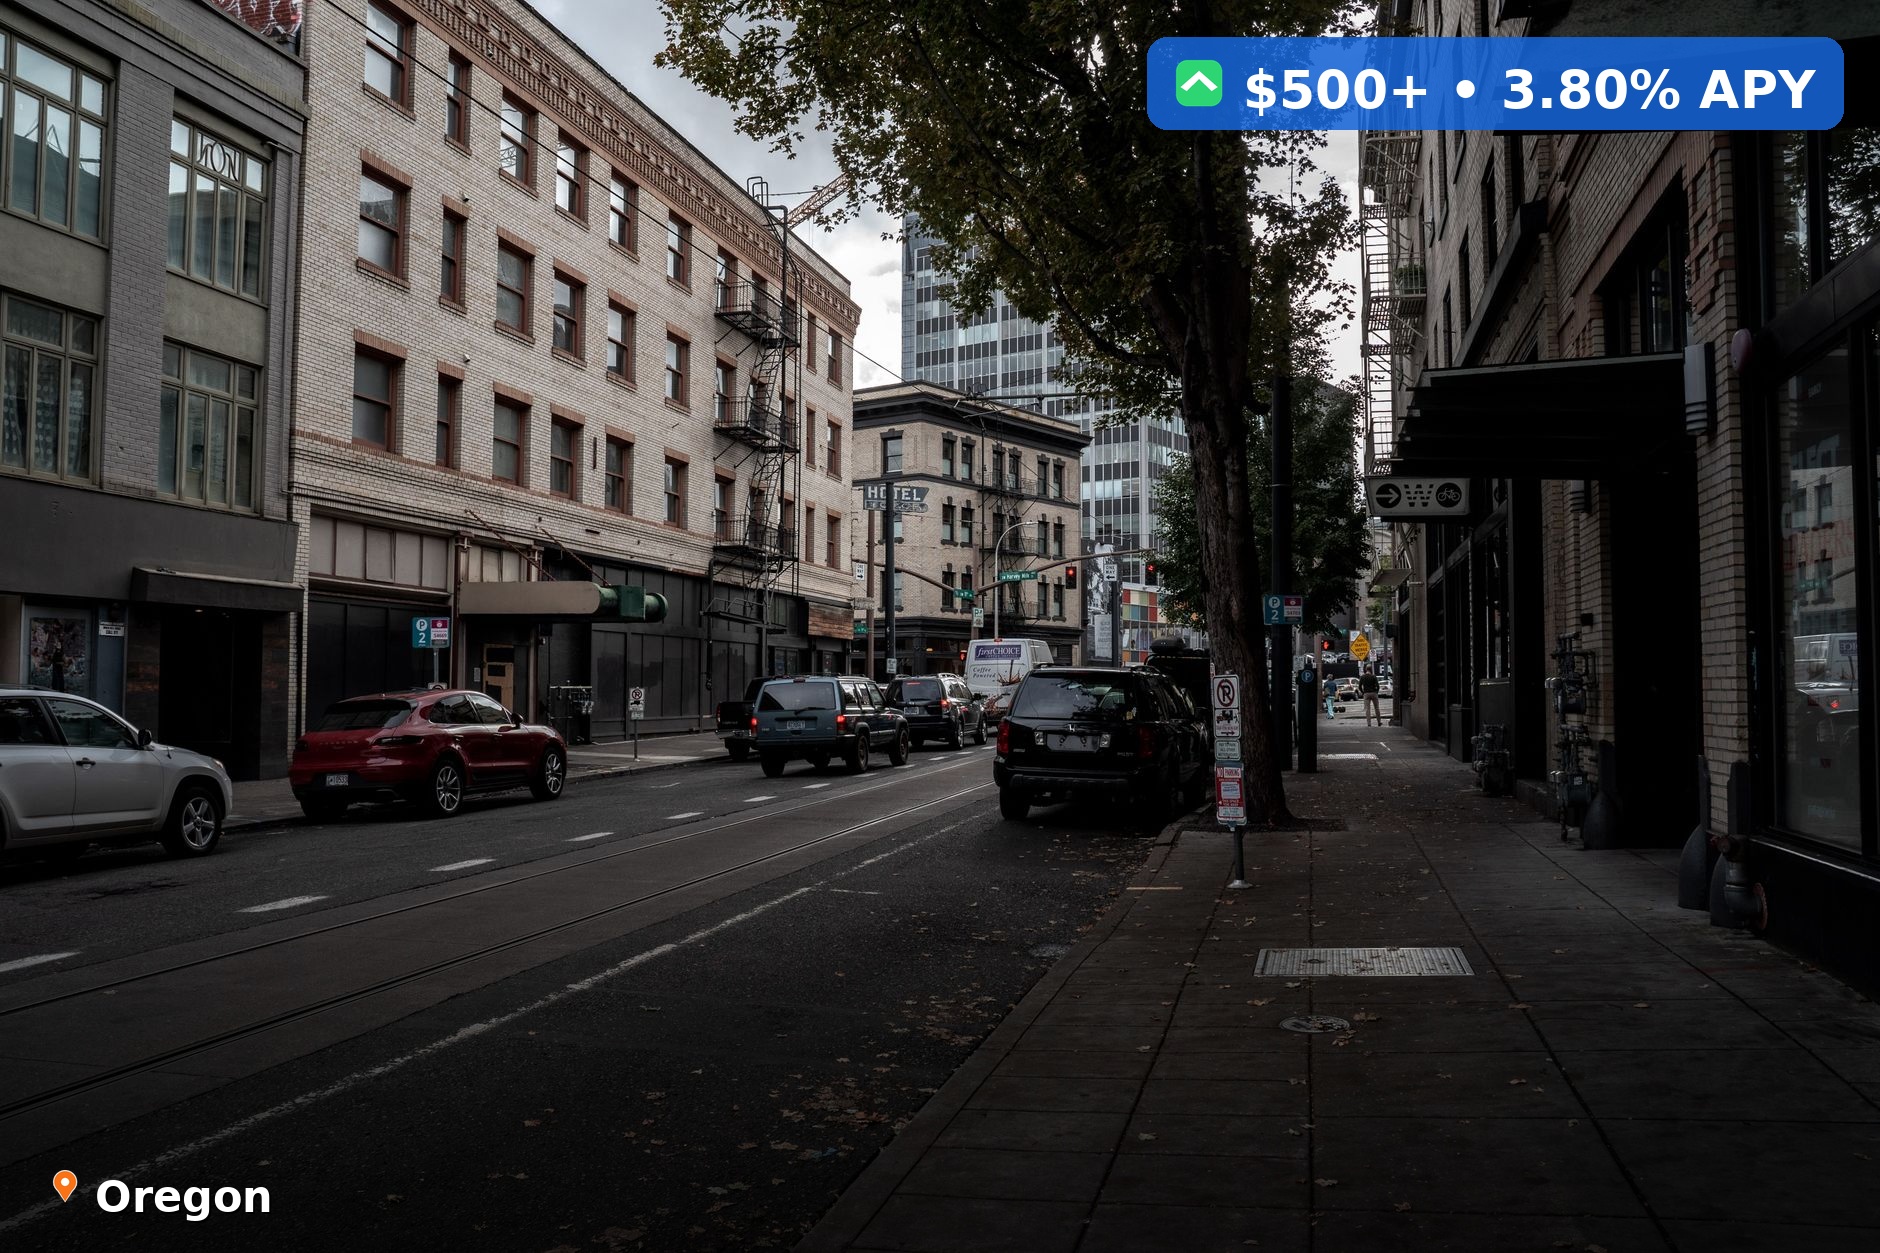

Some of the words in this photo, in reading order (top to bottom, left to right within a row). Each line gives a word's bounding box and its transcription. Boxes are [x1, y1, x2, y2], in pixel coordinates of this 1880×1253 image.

[867, 486, 921, 501] HOTEL
[1271, 610, 1279, 620] 2
[418, 632, 426, 643] 2
[1217, 767, 1223, 778] NO
[1224, 768, 1241, 777] PARKING
